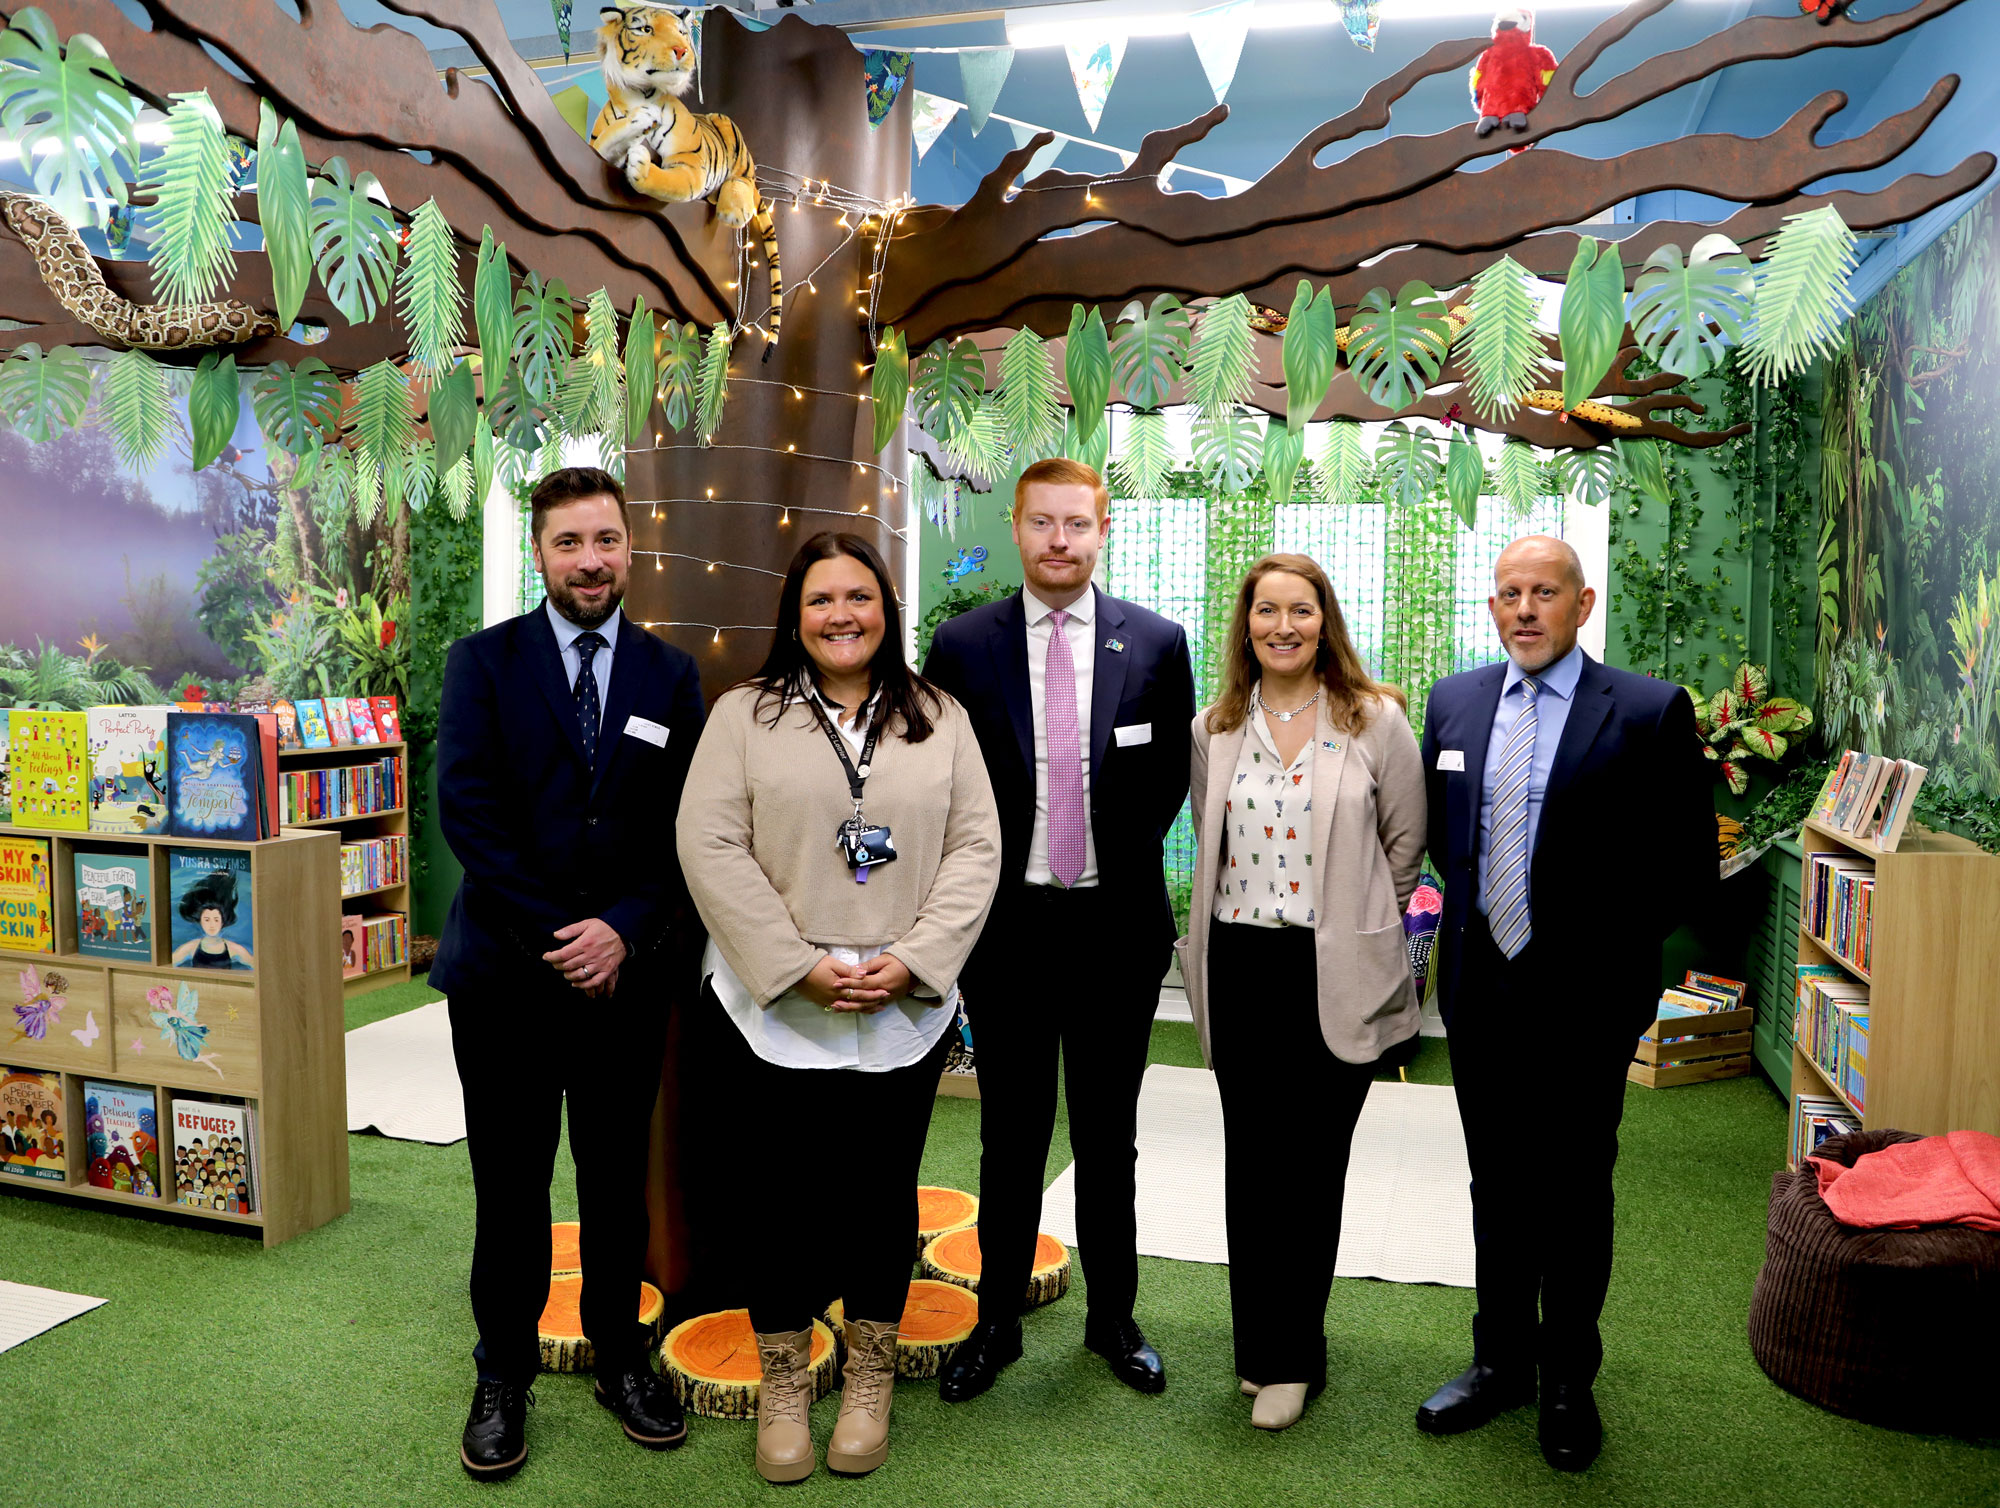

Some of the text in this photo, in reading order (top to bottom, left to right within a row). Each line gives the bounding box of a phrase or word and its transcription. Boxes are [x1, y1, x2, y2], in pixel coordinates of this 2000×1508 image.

[99, 719, 155, 741] Perfect Party
[31, 751, 61, 760] All About
[29, 762, 63, 776] Feelings
[3, 849, 24, 865] MY
[179, 856, 211, 869] YUSRA
[0, 866, 31, 883] SKIN
[0, 900, 37, 918] YOUR
[0, 920, 34, 938] SKIN
[10, 1087, 44, 1100] PEOPLE
[3, 1094, 54, 1109] REMEMBER
[113, 1097, 125, 1107] TEN
[178, 1112, 236, 1136] REFUGEE?
